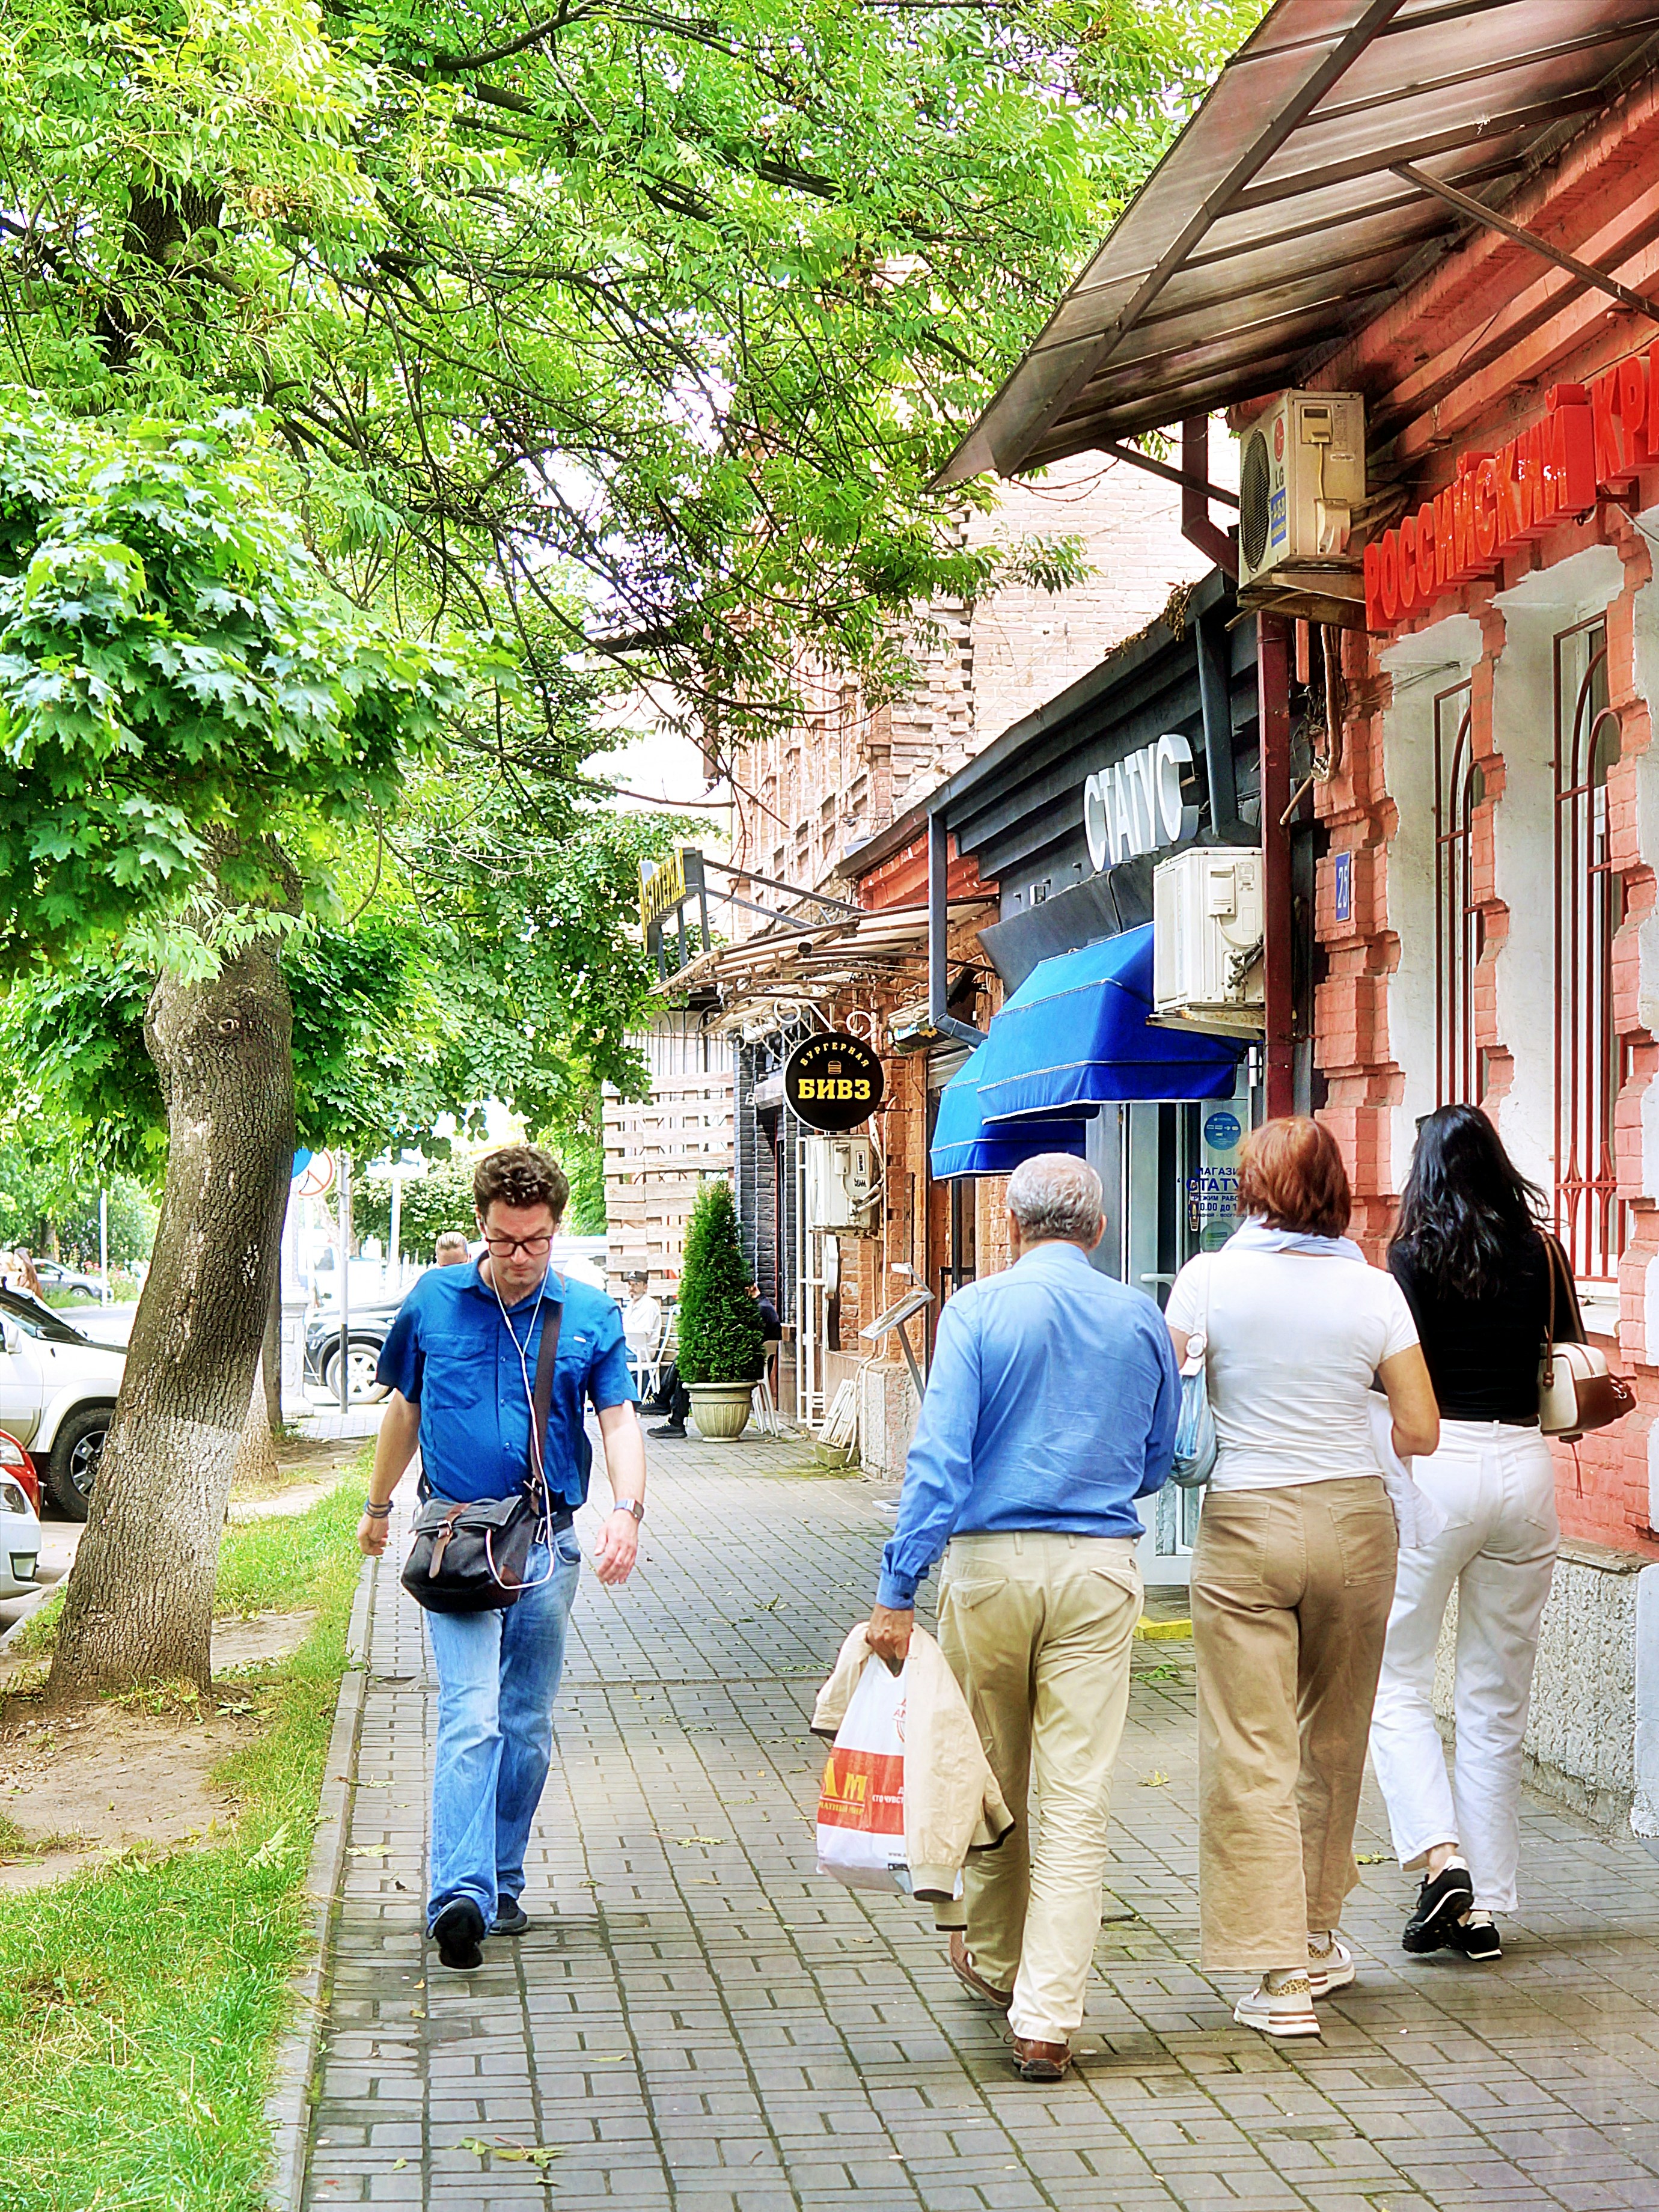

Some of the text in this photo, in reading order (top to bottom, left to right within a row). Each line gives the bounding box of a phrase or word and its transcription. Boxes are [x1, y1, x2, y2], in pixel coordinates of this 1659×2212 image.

[1275, 466, 1284, 490] LG
[1364, 339, 1659, 631] РОССИЙСКИЙ КР
[1084, 734, 1195, 872] СТАТУС
[1337, 865, 1348, 908] 25
[799, 1042, 870, 1067] БУРГЕРНАЯ
[798, 1078, 871, 1100] БИВЗ
[1195, 1167, 1238, 1176] МАГАЗИ
[884, 1795, 904, 1804] ЧУВСТ
